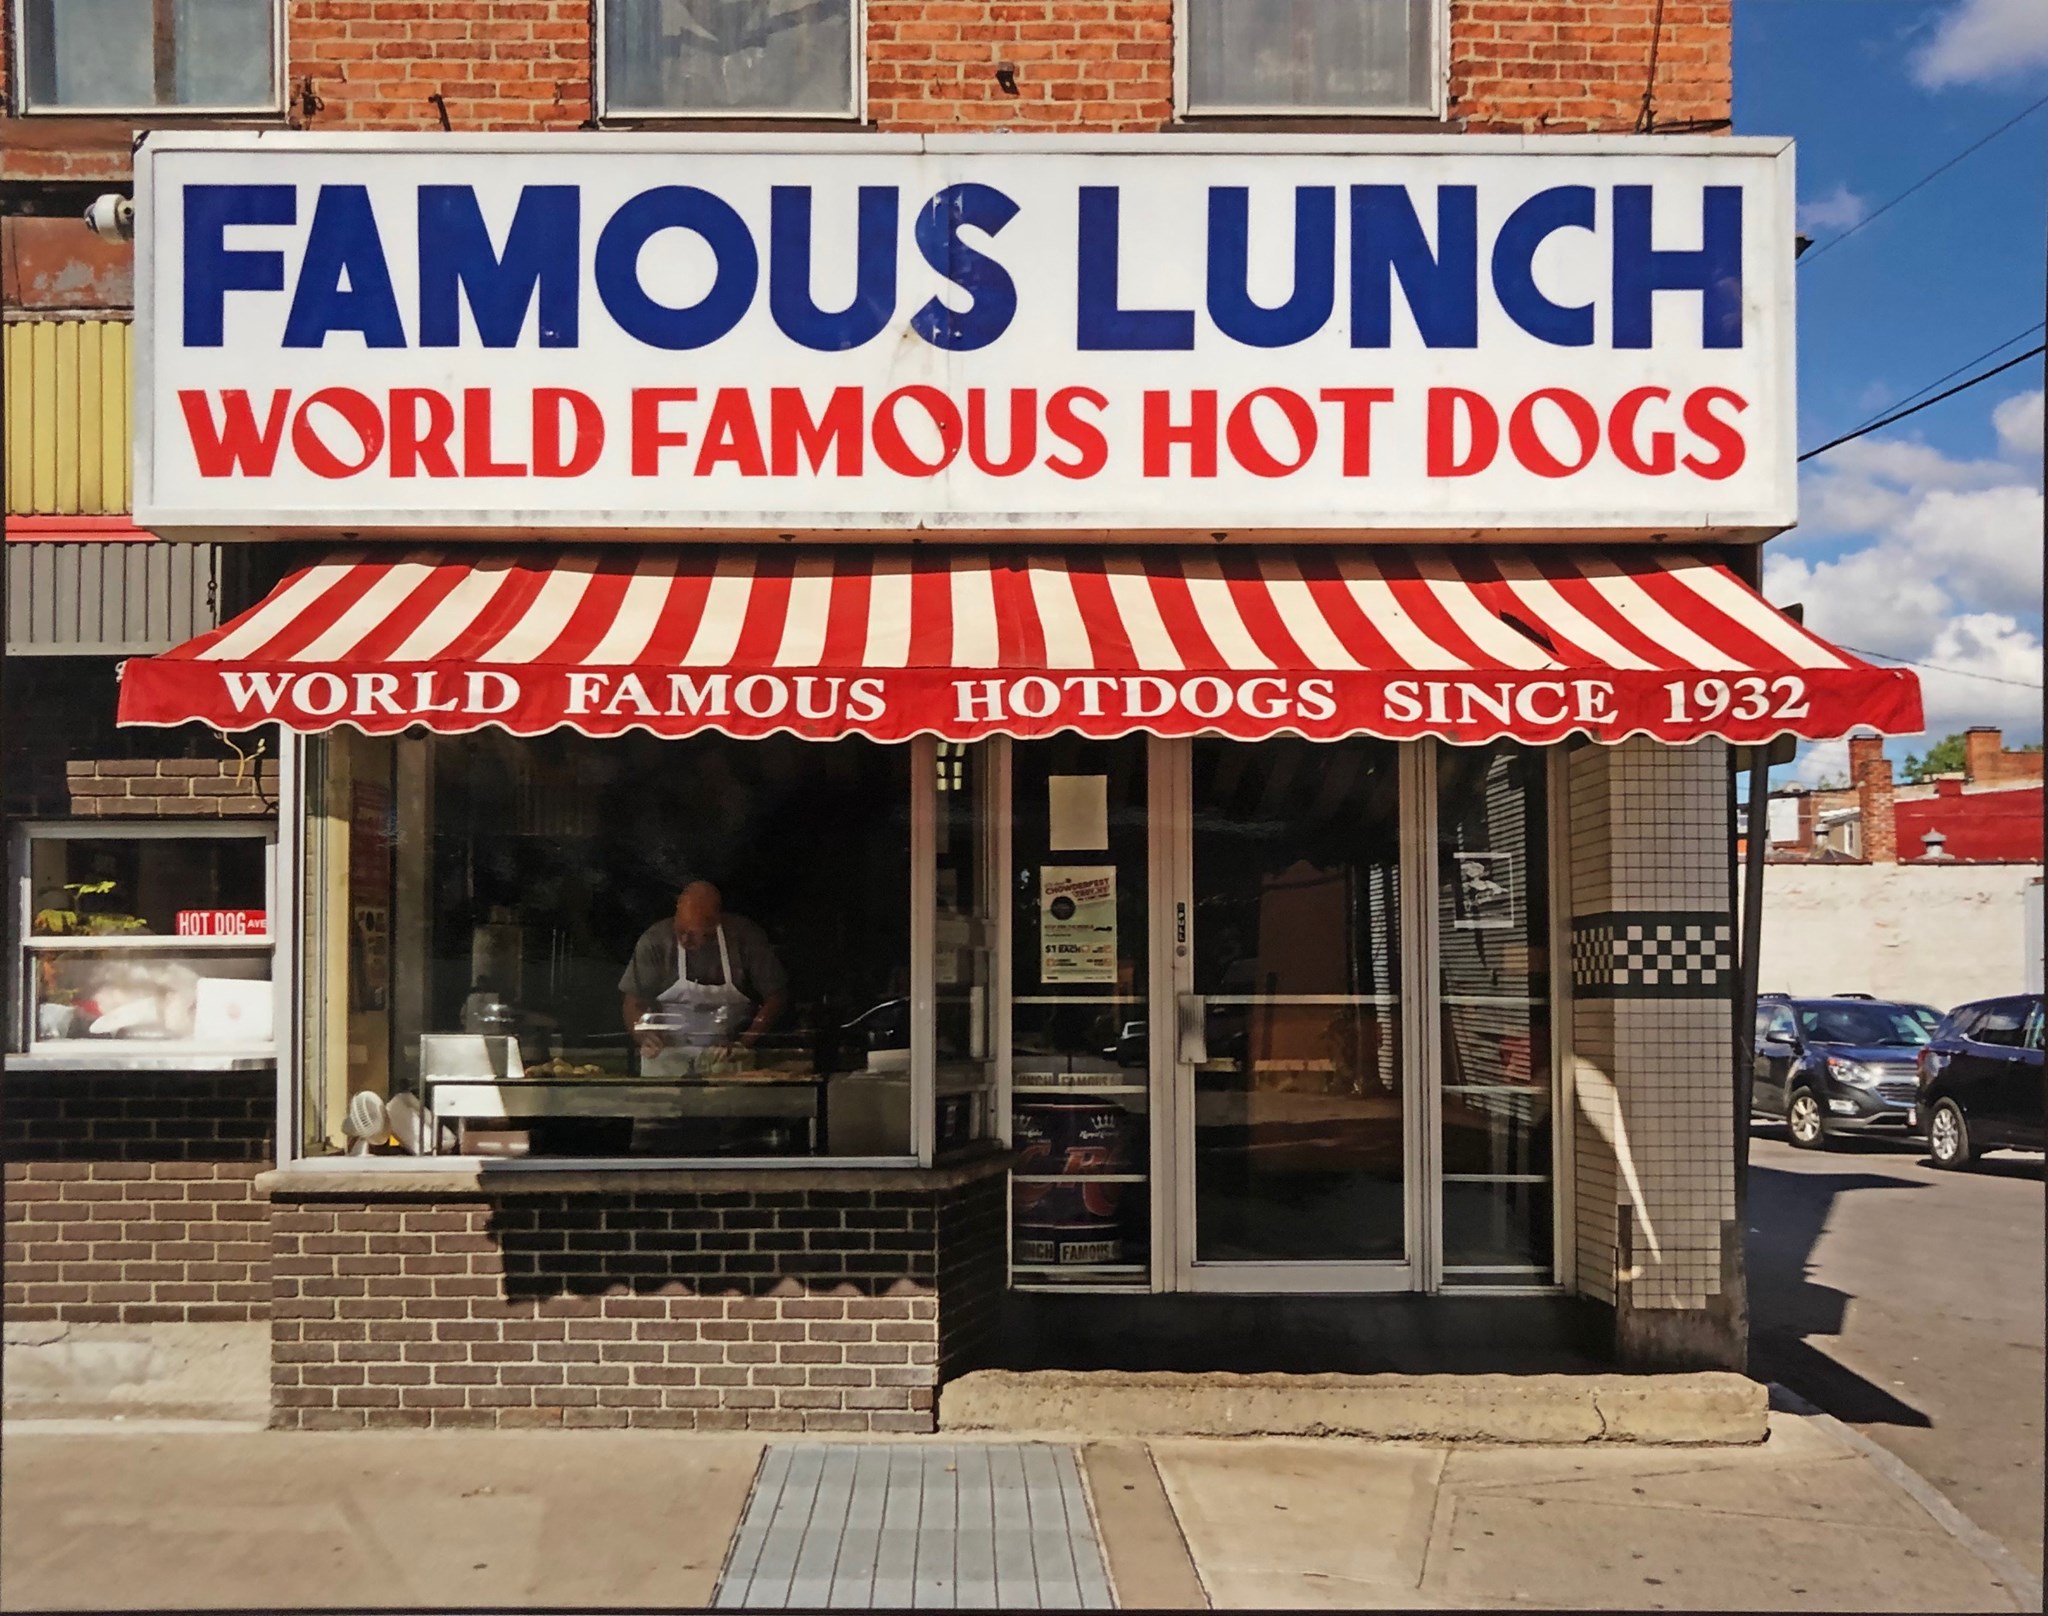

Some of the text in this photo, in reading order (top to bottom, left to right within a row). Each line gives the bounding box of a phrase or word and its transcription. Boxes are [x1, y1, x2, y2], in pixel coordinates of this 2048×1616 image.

[183, 183, 1742, 351] FAMOUS LUNCH
[178, 384, 1748, 480] WORLD FAMOUS HOT DOGS
[219, 671, 1812, 727] WORLD FAMOUS HOTDOGS SINCE 1932
[179, 911, 268, 936] HOT DOG AVE
[1063, 1244, 1109, 1261] FAMOUS
